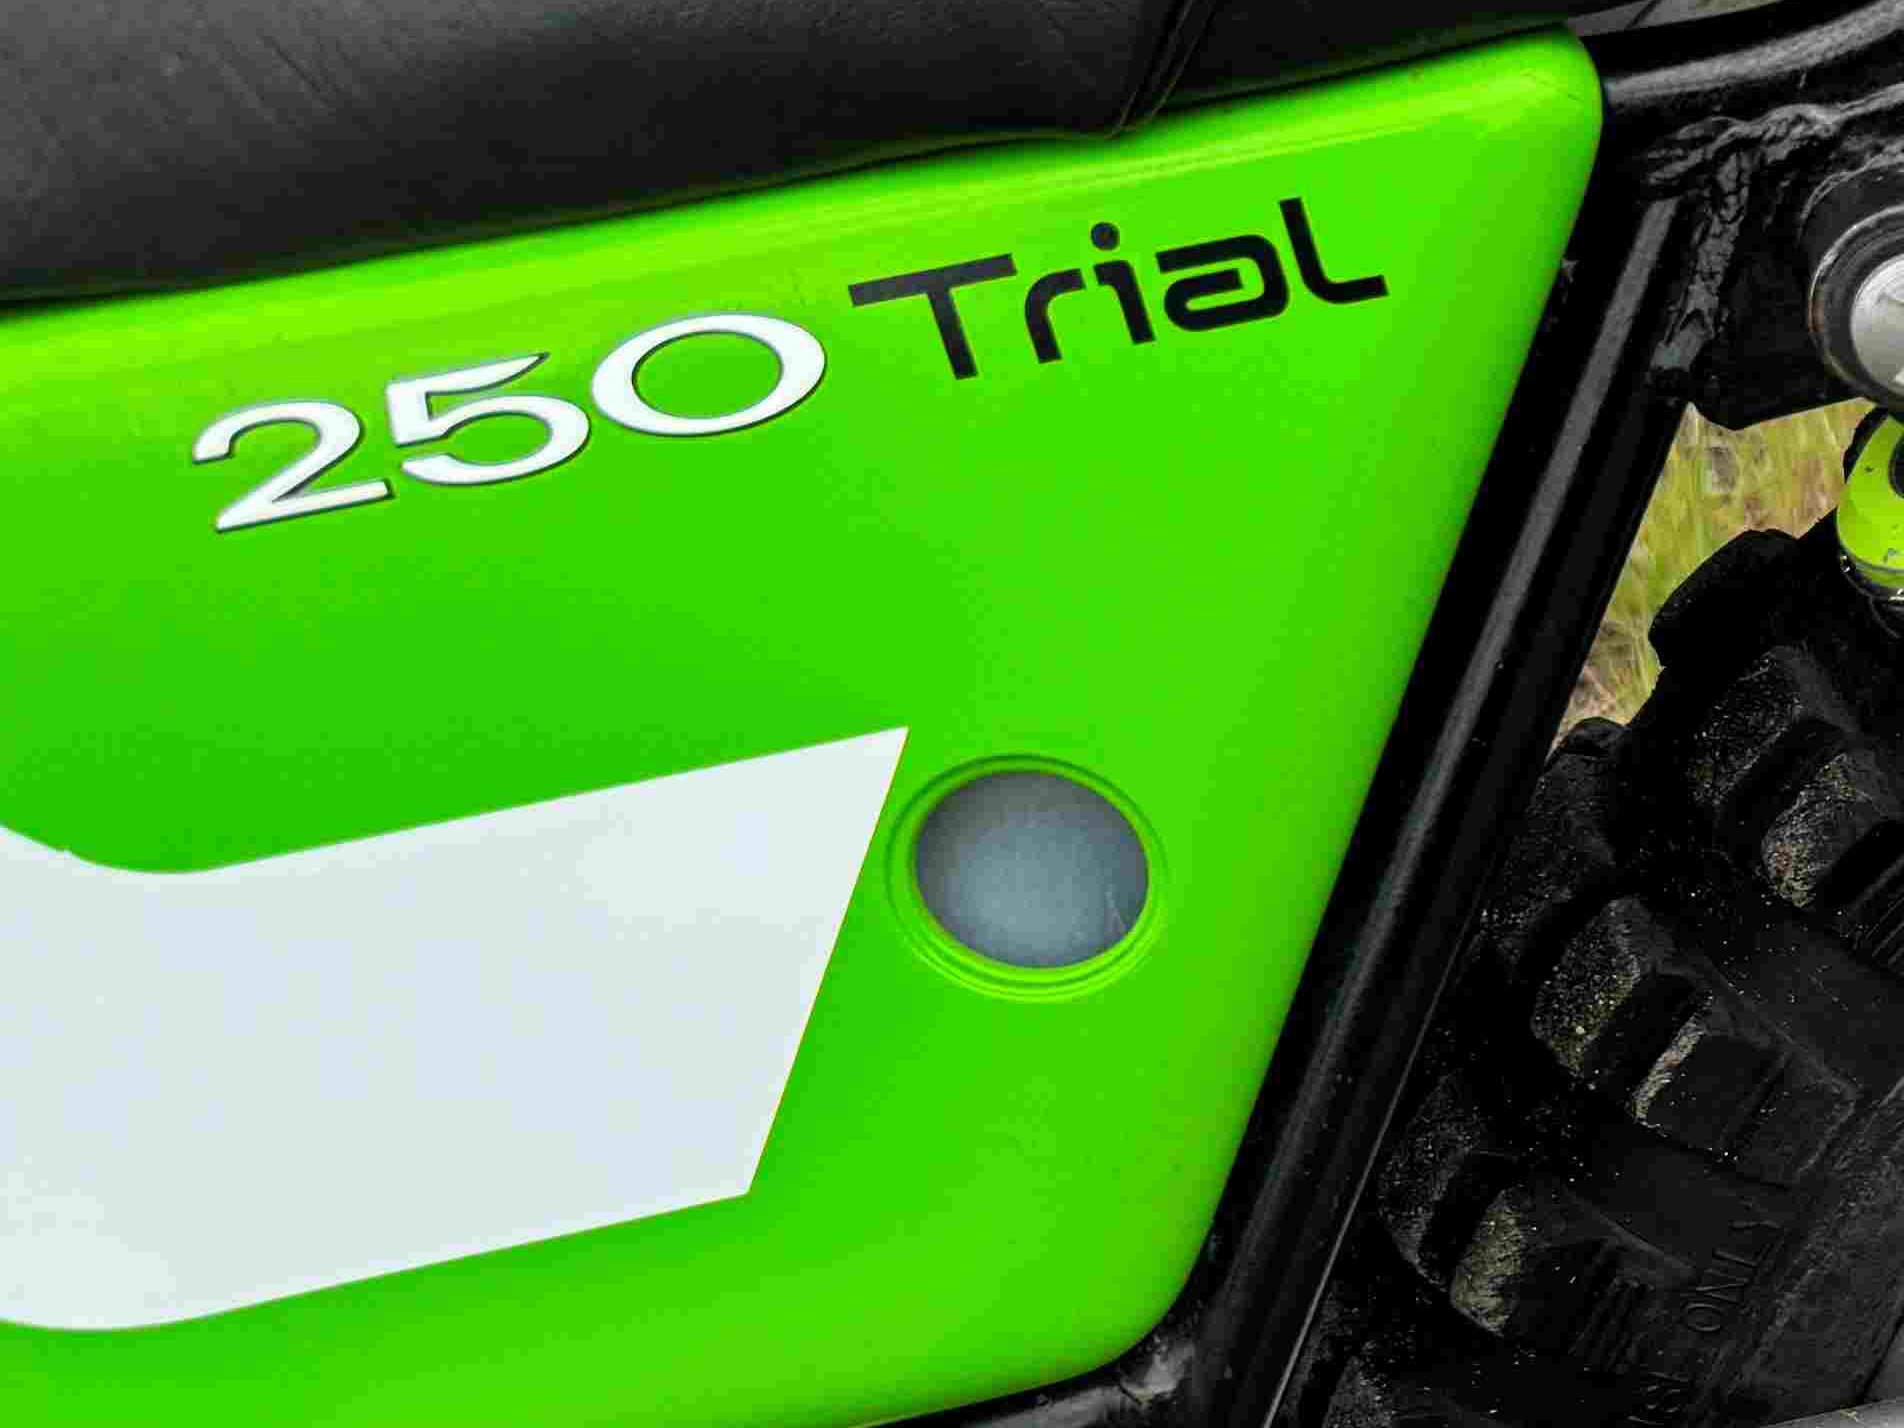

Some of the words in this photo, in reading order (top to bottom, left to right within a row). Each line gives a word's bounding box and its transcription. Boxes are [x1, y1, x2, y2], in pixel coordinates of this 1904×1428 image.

[190, 310, 829, 534] 250
[847, 197, 1389, 381] Trial
[1682, 1196, 1783, 1333] ONLY
